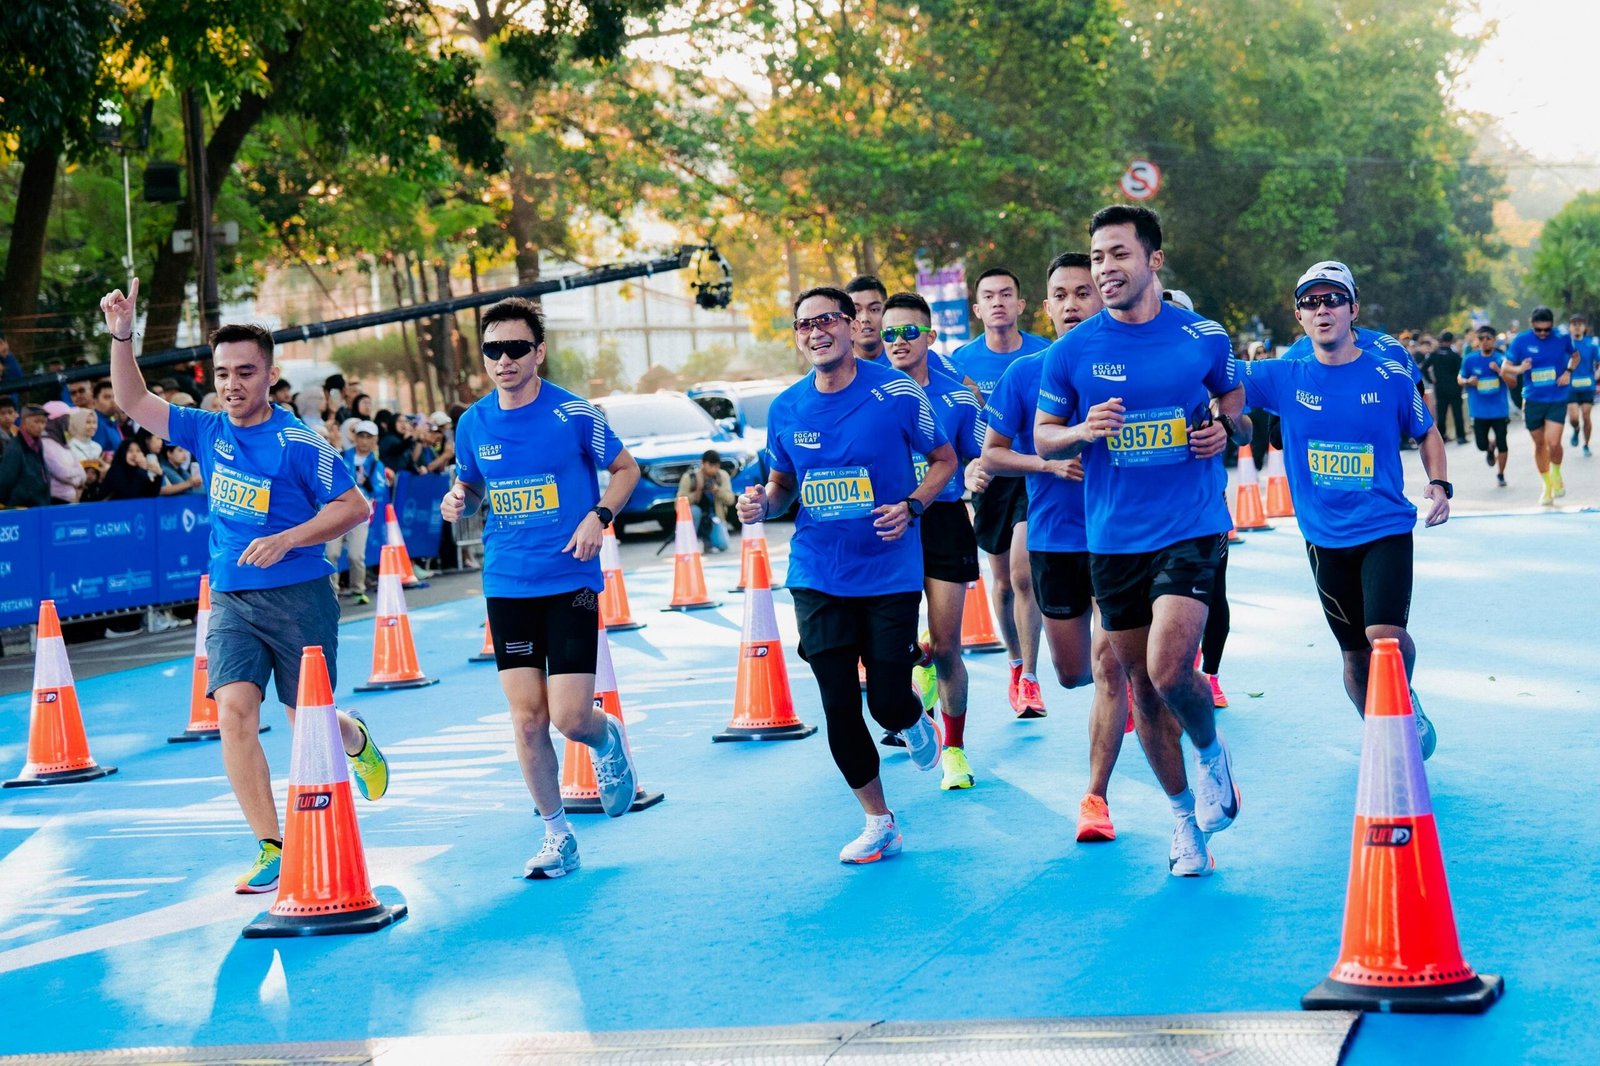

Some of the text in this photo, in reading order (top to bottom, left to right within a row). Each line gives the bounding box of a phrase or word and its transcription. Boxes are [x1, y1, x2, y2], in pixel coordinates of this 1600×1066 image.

[1131, 167, 1148, 191] S
[1181, 325, 1200, 339] 2XU
[1375, 366, 1390, 380] 2XU
[870, 388, 884, 402] 2XU
[1360, 392, 1381, 405] KML
[553, 408, 568, 422] 2XU
[1111, 423, 1173, 449] 39573
[478, 444, 502, 452] POCARI
[1311, 453, 1361, 475] 31200
[213, 476, 257, 509] 39572
[493, 488, 545, 513] 39575
[804, 480, 860, 505] 00004
[94, 521, 132, 538] GARMIN
